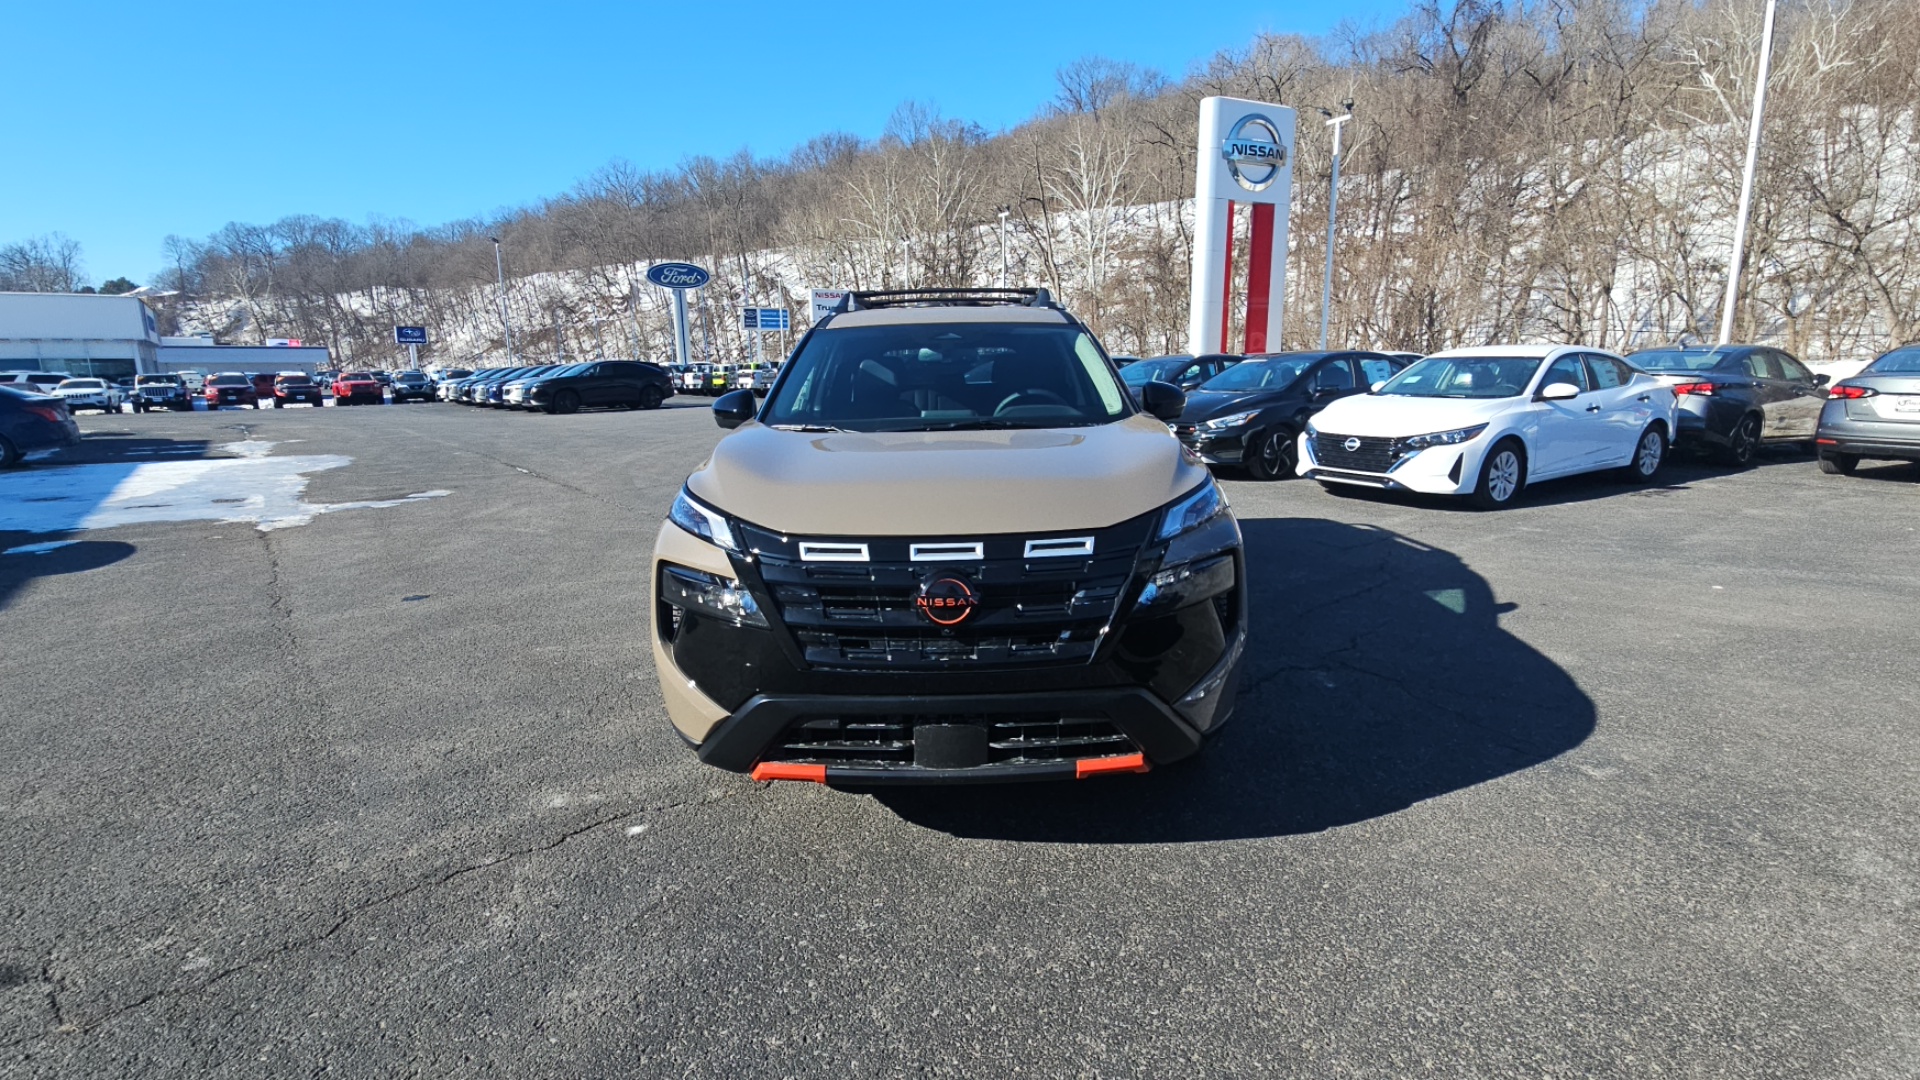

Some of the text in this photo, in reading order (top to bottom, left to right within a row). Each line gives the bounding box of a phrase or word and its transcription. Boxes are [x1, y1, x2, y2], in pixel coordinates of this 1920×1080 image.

[1231, 143, 1284, 161] NISSAN
[660, 267, 698, 284] Ford
[917, 597, 978, 607] NISSAN
